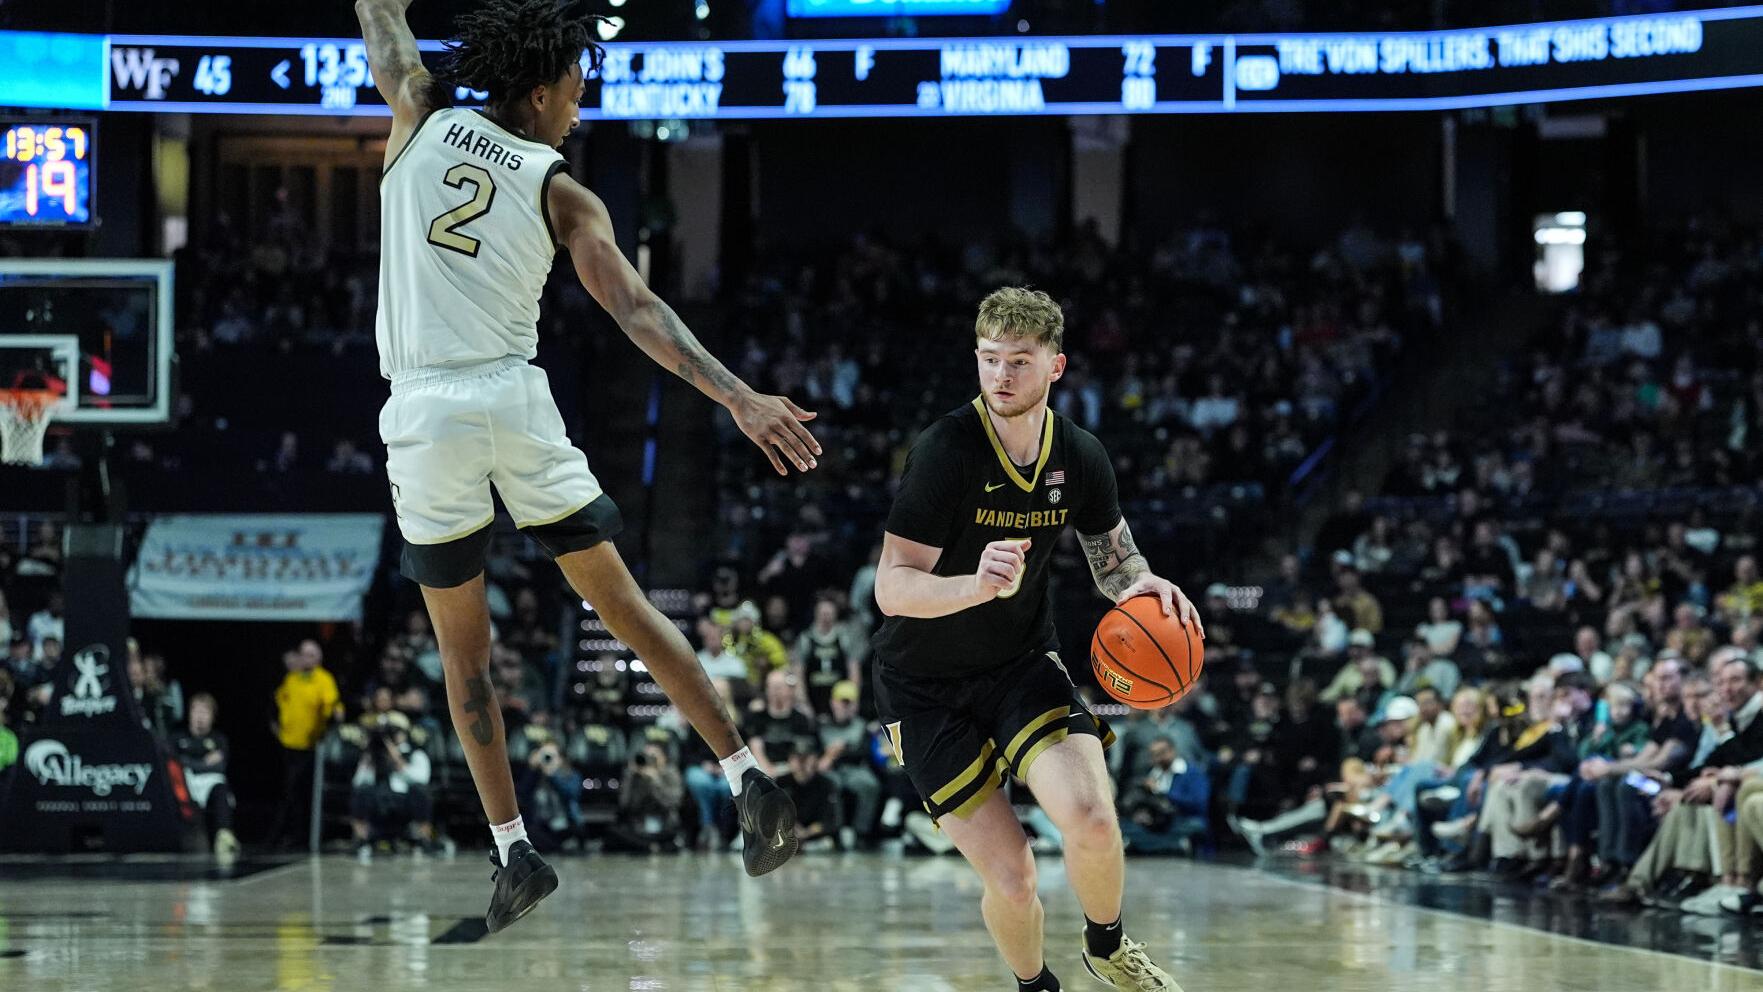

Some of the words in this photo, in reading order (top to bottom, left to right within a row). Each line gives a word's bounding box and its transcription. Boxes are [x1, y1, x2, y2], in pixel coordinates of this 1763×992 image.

[194, 55, 231, 95] 45
[855, 45, 876, 81] F
[940, 42, 1070, 78] MARYLAND
[1192, 40, 1213, 77] F
[7, 127, 85, 162] 13:57
[443, 123, 524, 171] HARRIS
[26, 160, 76, 216] 19
[427, 162, 497, 258] 2
[975, 507, 1069, 529] VANDEBILT
